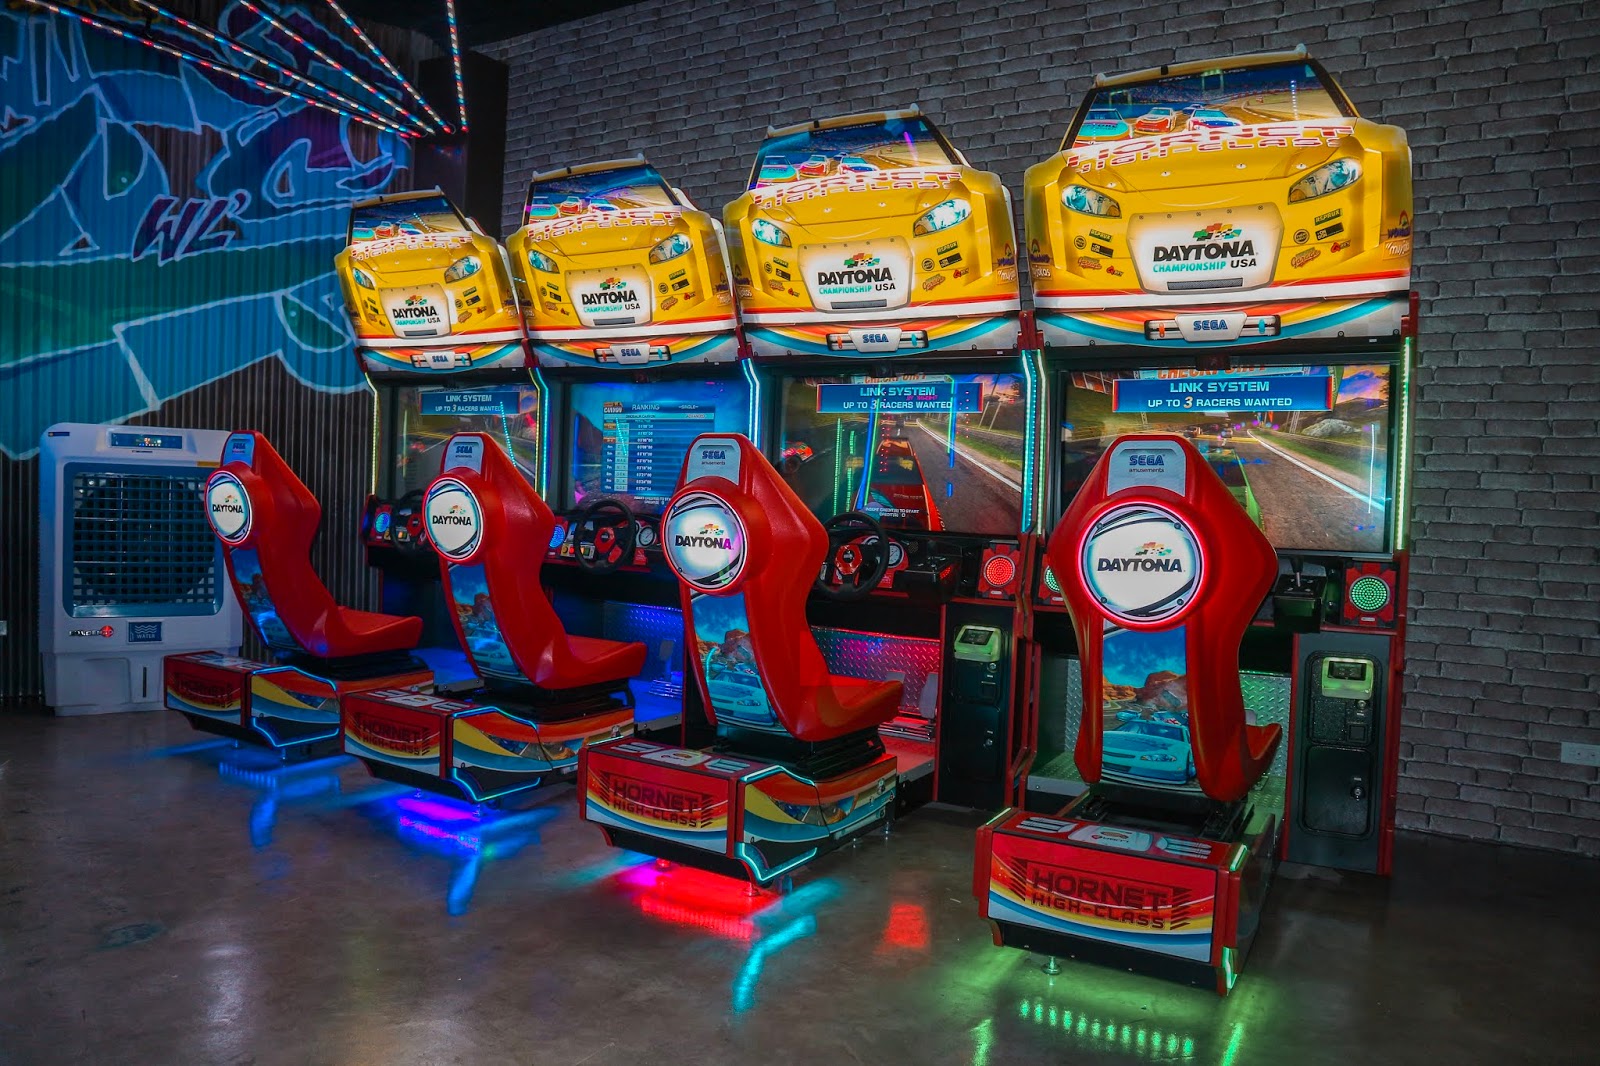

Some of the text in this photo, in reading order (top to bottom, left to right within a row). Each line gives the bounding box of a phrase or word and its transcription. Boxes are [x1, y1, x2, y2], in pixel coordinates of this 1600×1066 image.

[1067, 125, 1354, 168] HORNET
[752, 171, 963, 205] HORNET
[527, 211, 682, 238] HORNET
[1153, 240, 1255, 262] DAYTONA
[1153, 257, 1257, 273] CHAMPIONSHIP USA
[817, 267, 893, 286] DAYTONA
[818, 283, 896, 295] CHAMPIONSHIP USA
[581, 290, 637, 305] DAYTONA
[392, 306, 437, 319] DAYTONA
[583, 303, 641, 313] CHAMPIONSHIP USA
[1193, 319, 1229, 331] SEGA
[862, 333, 889, 343] SEGA
[431, 355, 449, 363] SEGA
[620, 349, 641, 357] SEGA
[860, 387, 936, 397] LINK SYSTEM
[1170, 381, 1270, 393] LINK SYSTEM
[462, 394, 492, 402] SYSTEM
[1148, 396, 1292, 409] UP TO 3 RACERS WANTED
[451, 404, 457, 412] 3
[870, 400, 878, 410] 3
[879, 401, 914, 409] RACERS
[915, 401, 953, 409] WANTED
[702, 450, 726, 459] SEGA
[1129, 455, 1164, 466] SEGA
[212, 504, 244, 513] DAYTONA
[432, 515, 472, 526] DAYTONA
[675, 534, 732, 550] DAYTONA
[1097, 558, 1183, 573] DAYTONA
[363, 719, 420, 743] HORNET
[363, 734, 420, 756] HIGH-CLASS
[613, 781, 699, 814] HORNET
[613, 800, 698, 828] HIGH-CLASS
[1031, 869, 1169, 913] HORNET
[1032, 893, 1167, 930] HIGH-CLASS
